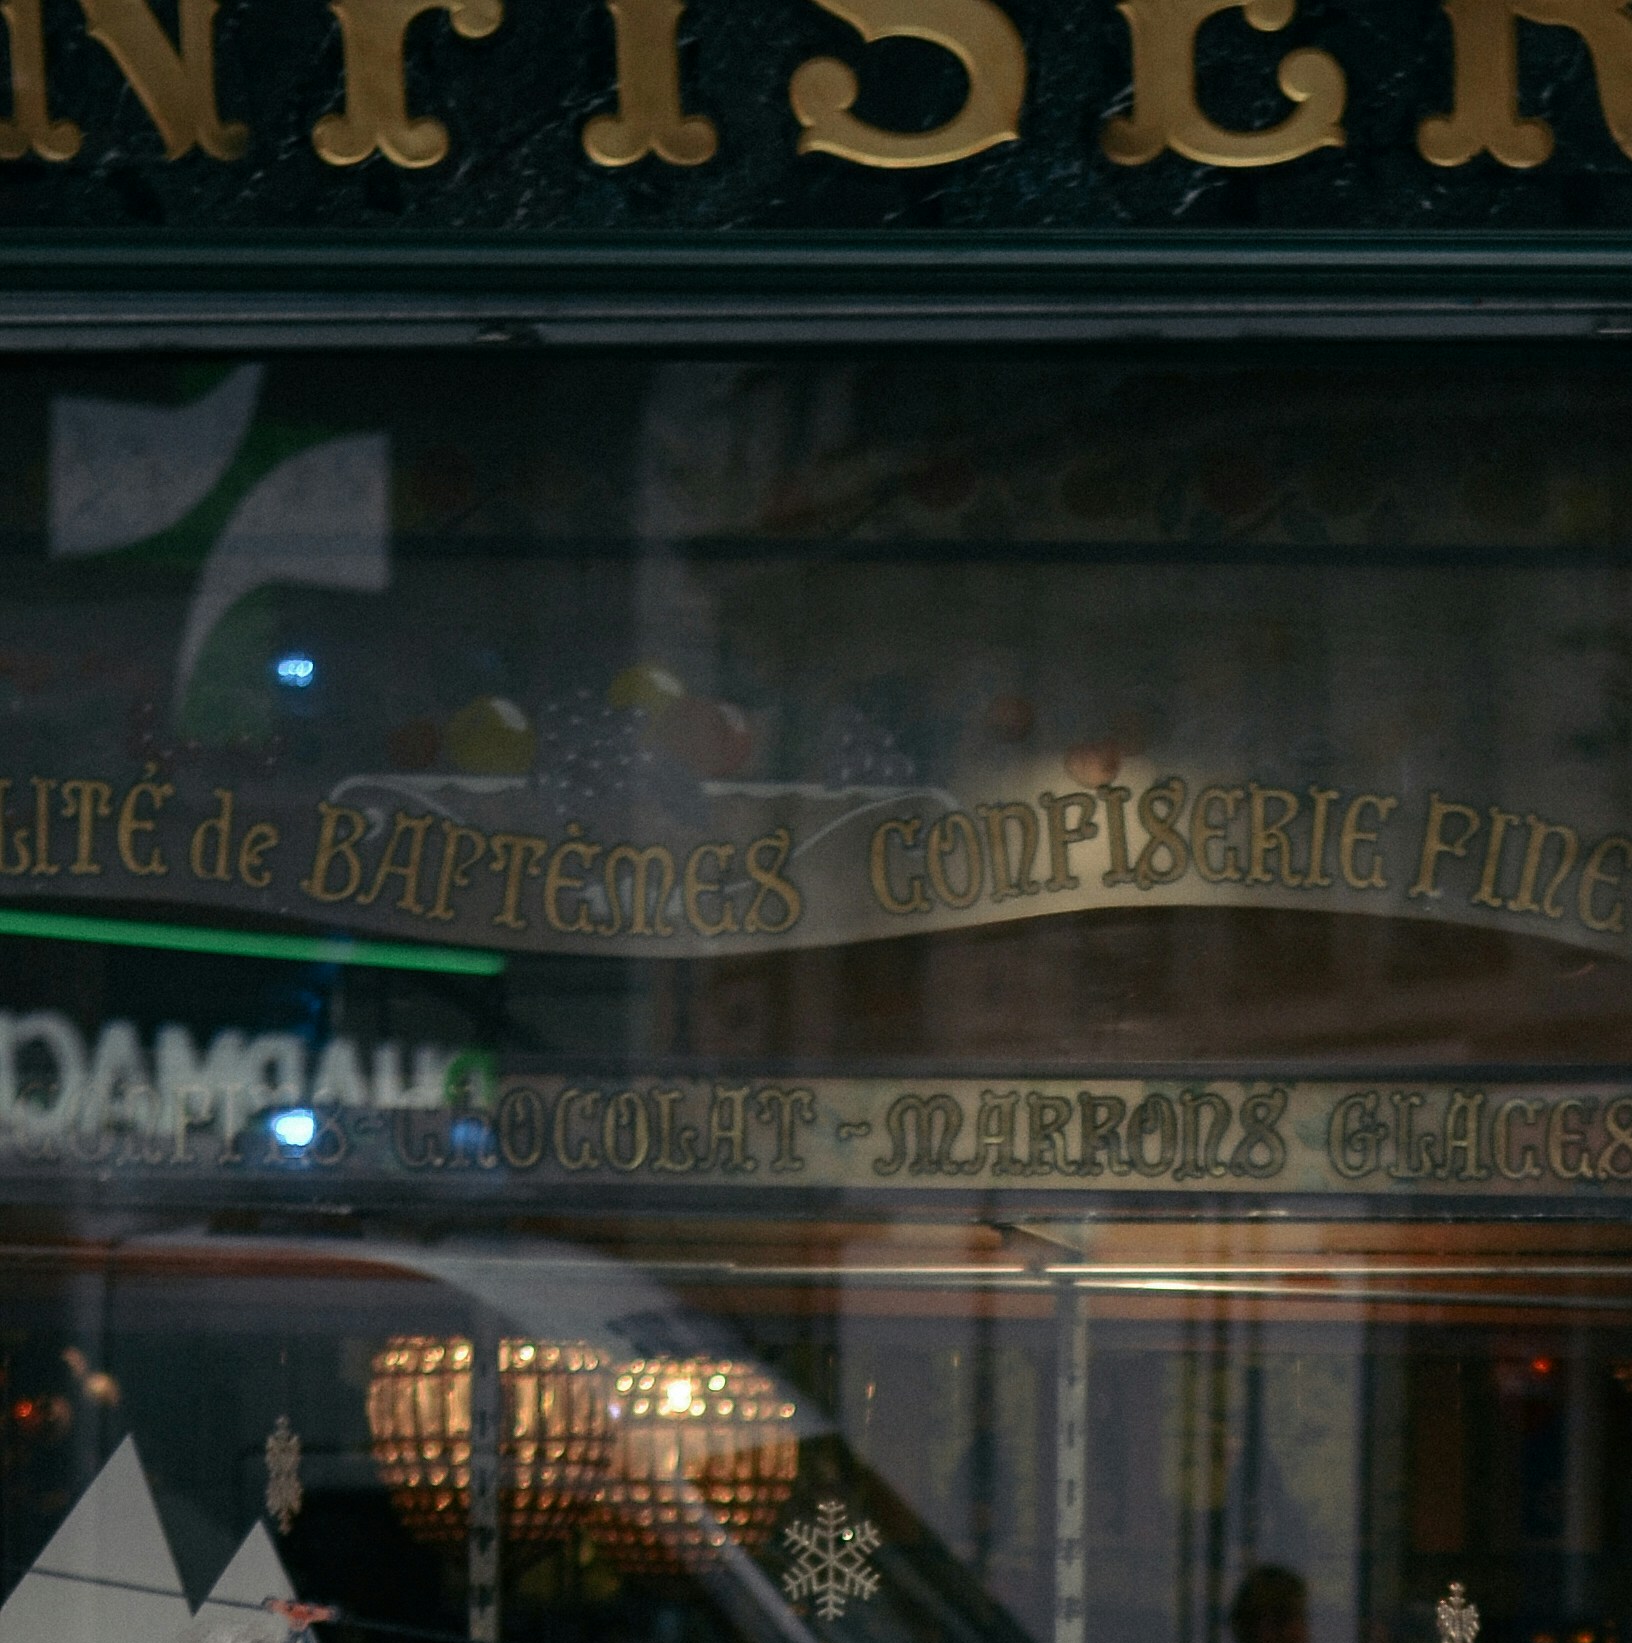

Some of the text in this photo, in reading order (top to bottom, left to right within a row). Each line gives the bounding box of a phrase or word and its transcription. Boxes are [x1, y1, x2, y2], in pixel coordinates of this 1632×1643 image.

[190, 789, 279, 888] de
[870, 776, 1398, 915] CONFISERIE
[872, 1087, 1289, 1184] MARRONS
